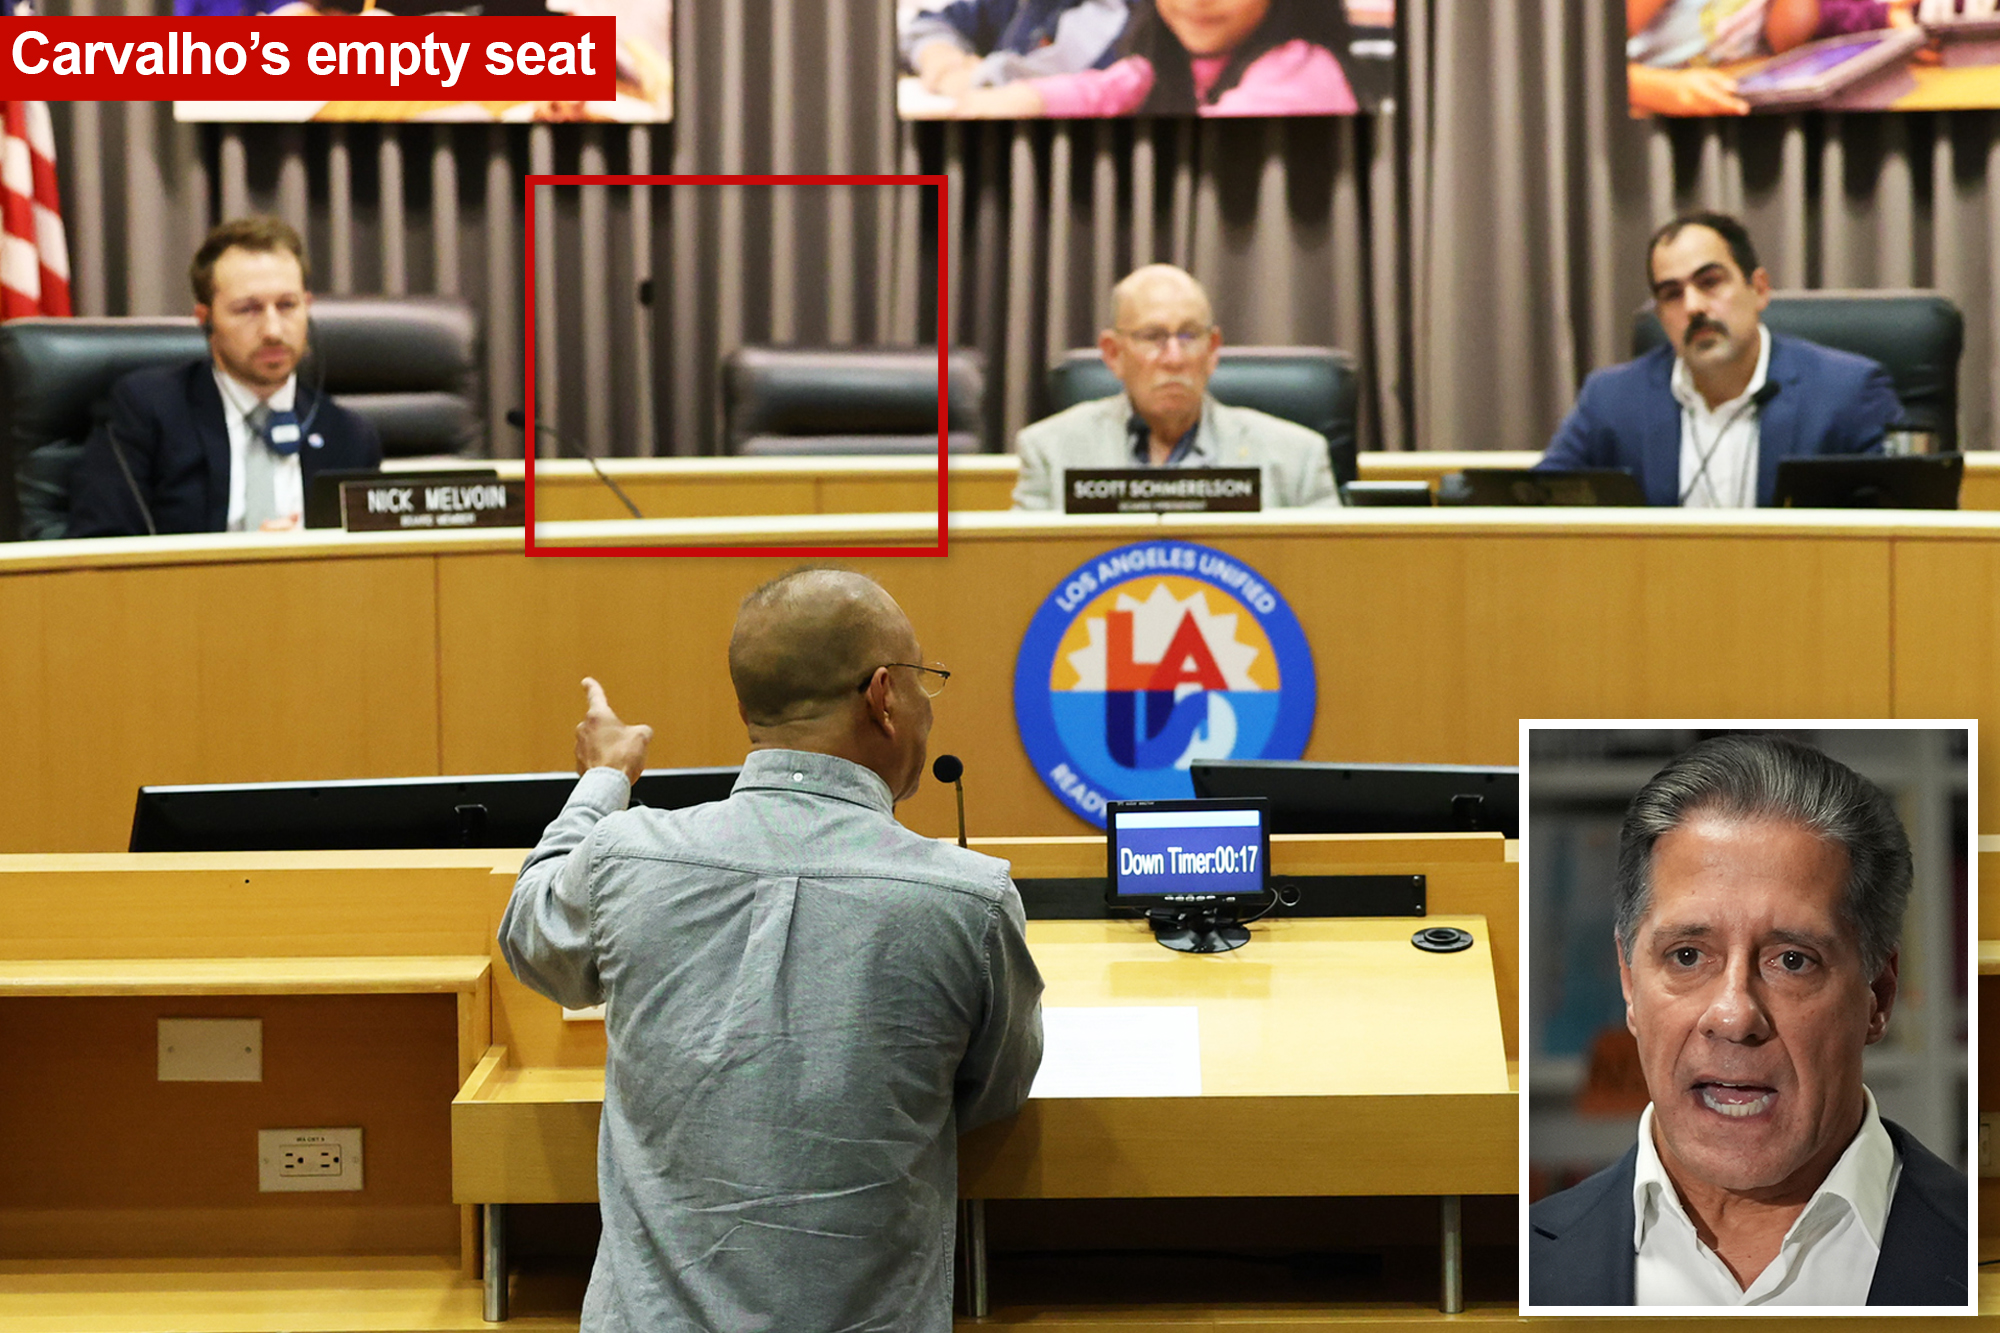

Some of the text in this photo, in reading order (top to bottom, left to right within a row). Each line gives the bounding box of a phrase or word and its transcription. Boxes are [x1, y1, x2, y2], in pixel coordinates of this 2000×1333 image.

[367, 485, 506, 513] NICK MELVOIN
[1074, 480, 1127, 499] SCOTT
[1056, 548, 1277, 614] LOS ANGELES UNIFIED
[1106, 607, 1229, 690] LA
[1120, 845, 1258, 876] Down Timer:00:17
